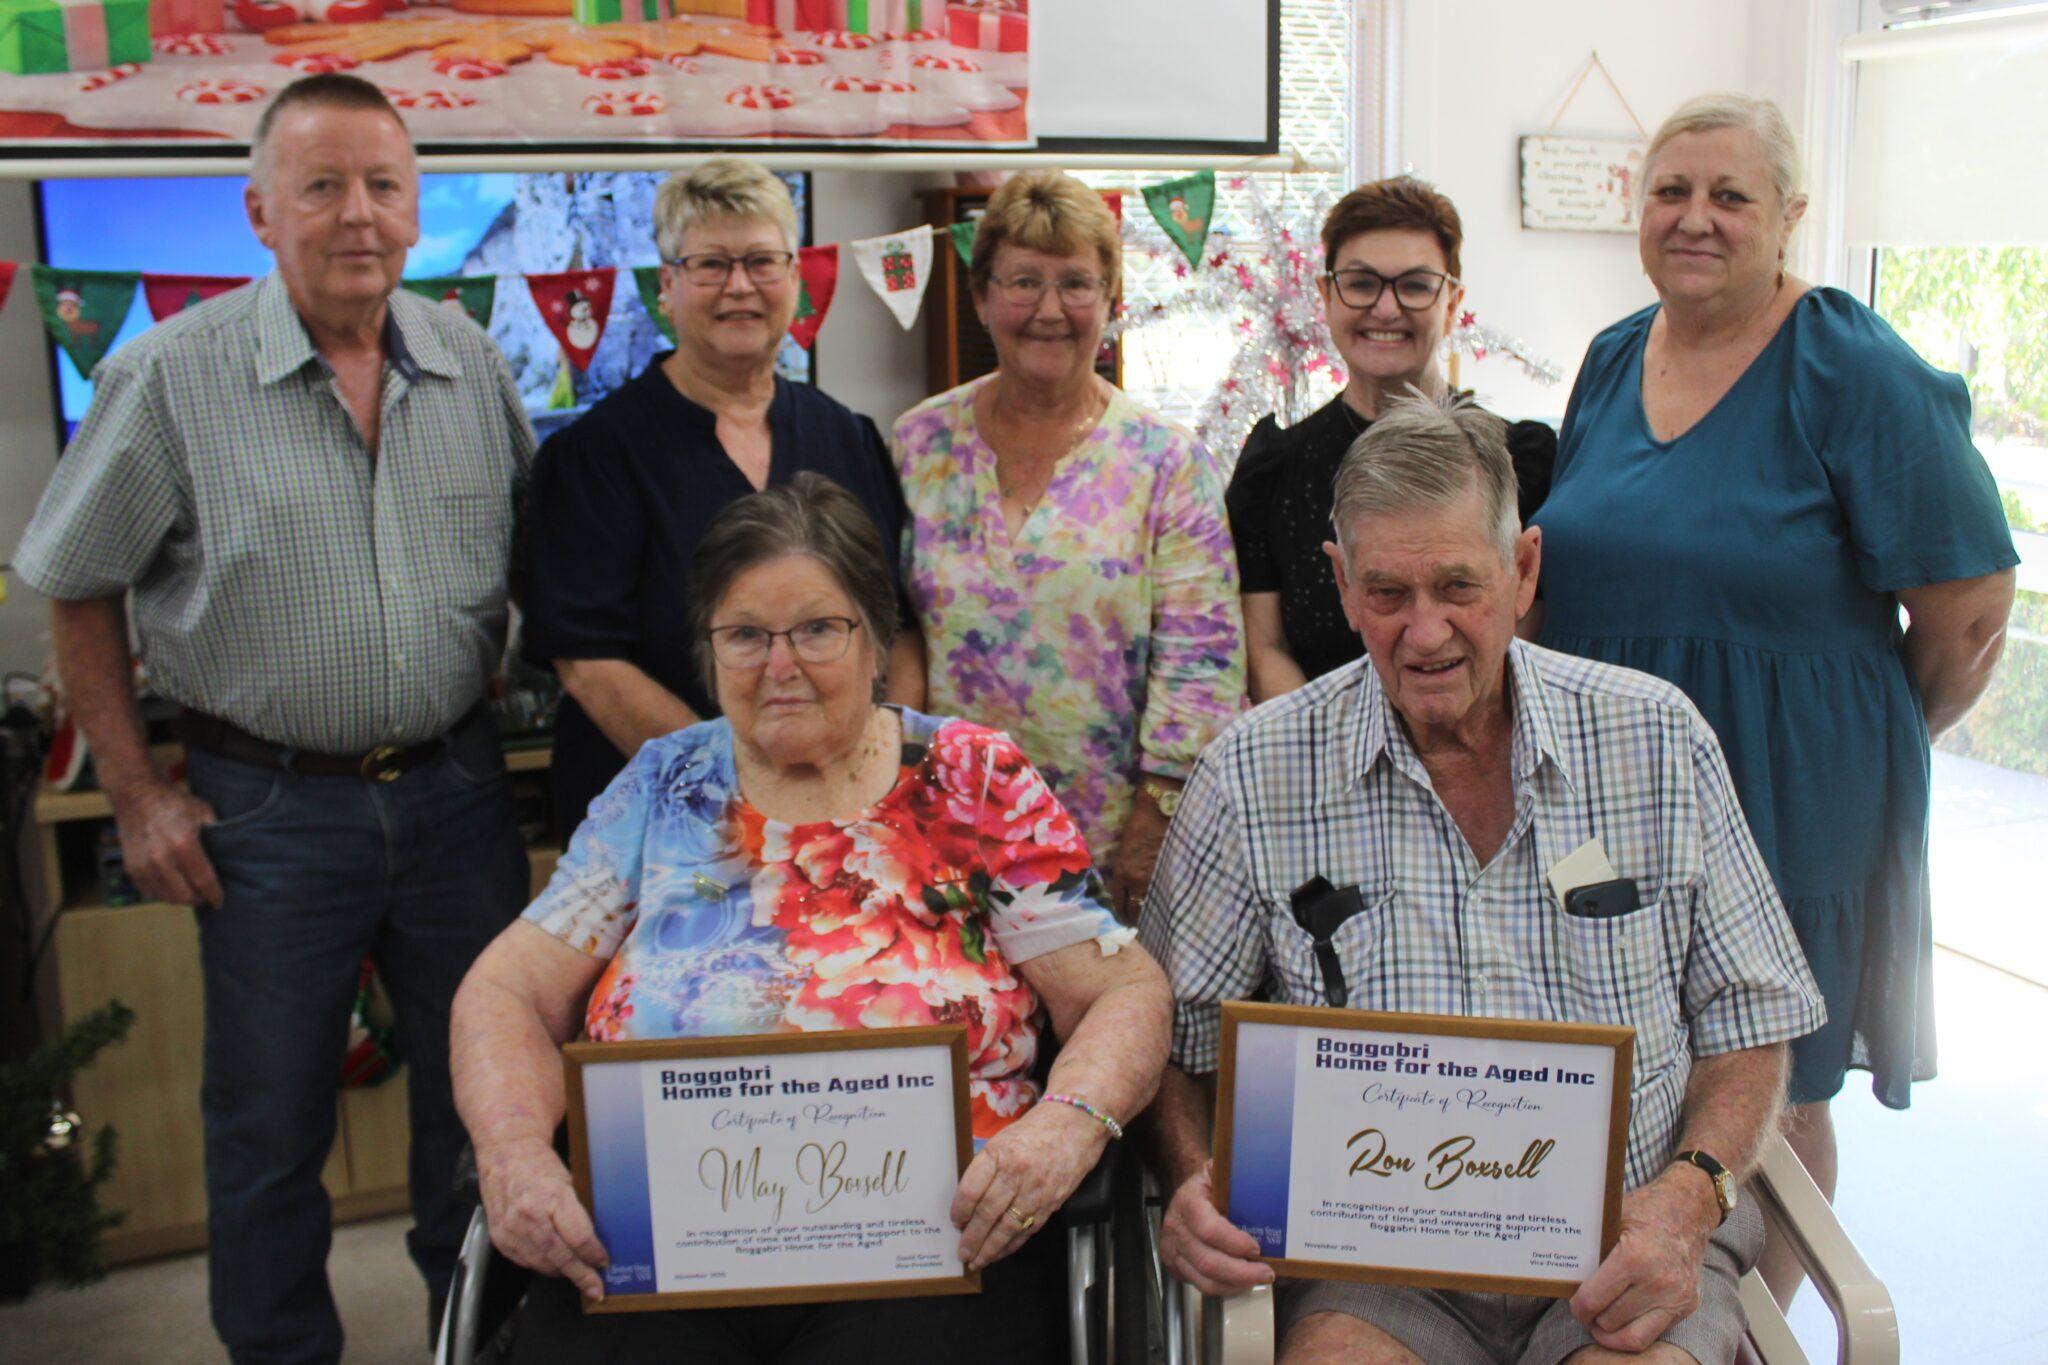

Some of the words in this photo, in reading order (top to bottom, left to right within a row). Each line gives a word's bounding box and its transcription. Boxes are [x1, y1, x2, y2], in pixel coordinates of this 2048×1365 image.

[1316, 1037, 1429, 1058] Boggabri
[661, 1065, 771, 1085] Boggabri
[1315, 1053, 1387, 1072] Home
[1395, 1058, 1431, 1074] for
[1437, 1061, 1478, 1078] the
[1484, 1064, 1548, 1083] Aged
[1556, 1068, 1595, 1085] Inc
[662, 1086, 732, 1101] Home
[739, 1082, 774, 1097] for
[781, 1079, 820, 1095] the
[828, 1074, 889, 1094] Aged
[897, 1074, 935, 1089] Inc
[1362, 1082, 1434, 1111] Certificate
[1438, 1096, 1451, 1114] of
[1456, 1088, 1543, 1116] Recognition
[1346, 1128, 1416, 1178] Ron
[1424, 1135, 1556, 1191] Boxsell
[698, 1146, 790, 1225] May
[1310, 1209, 1375, 1221] contribution
[1377, 1213, 1389, 1221] of
[1392, 1215, 1415, 1224] time
[1418, 1217, 1438, 1226] and
[1440, 1219, 1502, 1231] unwavering
[1505, 1223, 1545, 1233] support
[1550, 1226, 1561, 1234] to
[1564, 1226, 1582, 1235] the
[1322, 1200, 1332, 1208] In
[1335, 1201, 1395, 1212] recognition
[1412, 1208, 1436, 1216] your
[1440, 1209, 1502, 1221] outstanding
[1505, 1213, 1525, 1222] and
[1528, 1214, 1567, 1225] tireless
[675, 1239, 737, 1248] contribution
[742, 1236, 753, 1245] of
[782, 1234, 800, 1242] and
[866, 1228, 906, 1239] support
[924, 1226, 941, 1235] the
[686, 1229, 696, 1238] In
[699, 1226, 758, 1238] recognition
[760, 1226, 772, 1234] of
[775, 1225, 798, 1235] your
[801, 1221, 862, 1231] outstanding
[865, 1220, 884, 1229] and
[888, 1218, 926, 1227] tireless
[1370, 1222, 1417, 1233] Boggabri
[1420, 1225, 1450, 1235] Home
[1454, 1228, 1470, 1237] for
[1473, 1230, 1491, 1239] the
[1494, 1232, 1521, 1241] Aged
[735, 1246, 782, 1255] Boggabri
[784, 1244, 814, 1252] Home
[818, 1242, 833, 1250] for
[837, 1241, 854, 1249] the
[857, 1240, 883, 1249] Aged
[1532, 1251, 1552, 1259] David
[1529, 1260, 1579, 1269] Vice-President
